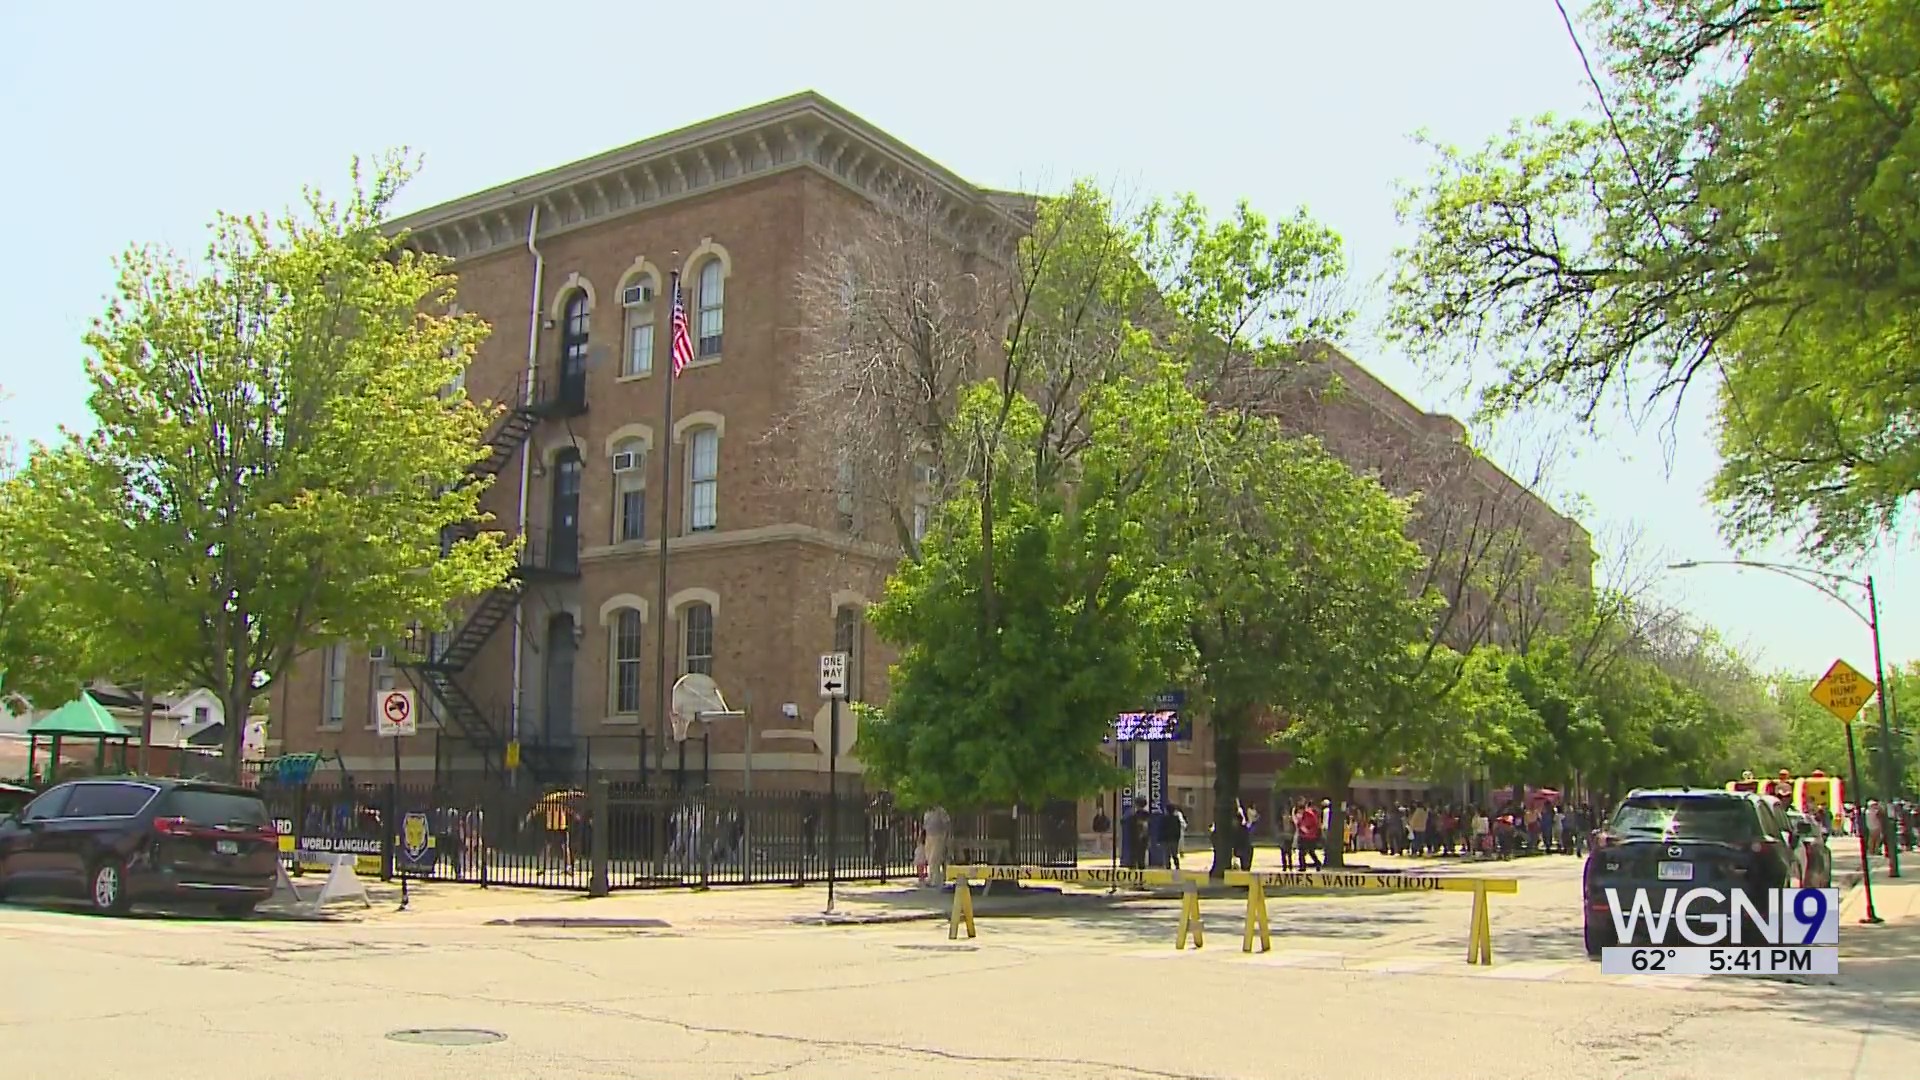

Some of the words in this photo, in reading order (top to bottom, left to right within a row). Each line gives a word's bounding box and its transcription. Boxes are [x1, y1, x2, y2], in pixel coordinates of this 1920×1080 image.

[823, 657, 842, 666] ONE
[823, 667, 843, 678] WAY
[1830, 686, 1857, 697] HUMP
[1830, 696, 1862, 708] AHEAD
[1151, 759, 1162, 814] JAGUARS
[272, 819, 293, 835] RD
[302, 836, 332, 851] WORLD
[333, 838, 382, 852] LANGUAGE
[988, 867, 1032, 880] JAMES
[1040, 868, 1079, 881] WARD
[1087, 869, 1147, 883] SCHOOL
[1265, 873, 1314, 887] JAMES
[1321, 874, 1366, 888] WARD
[1376, 875, 1445, 890] SCHOOL
